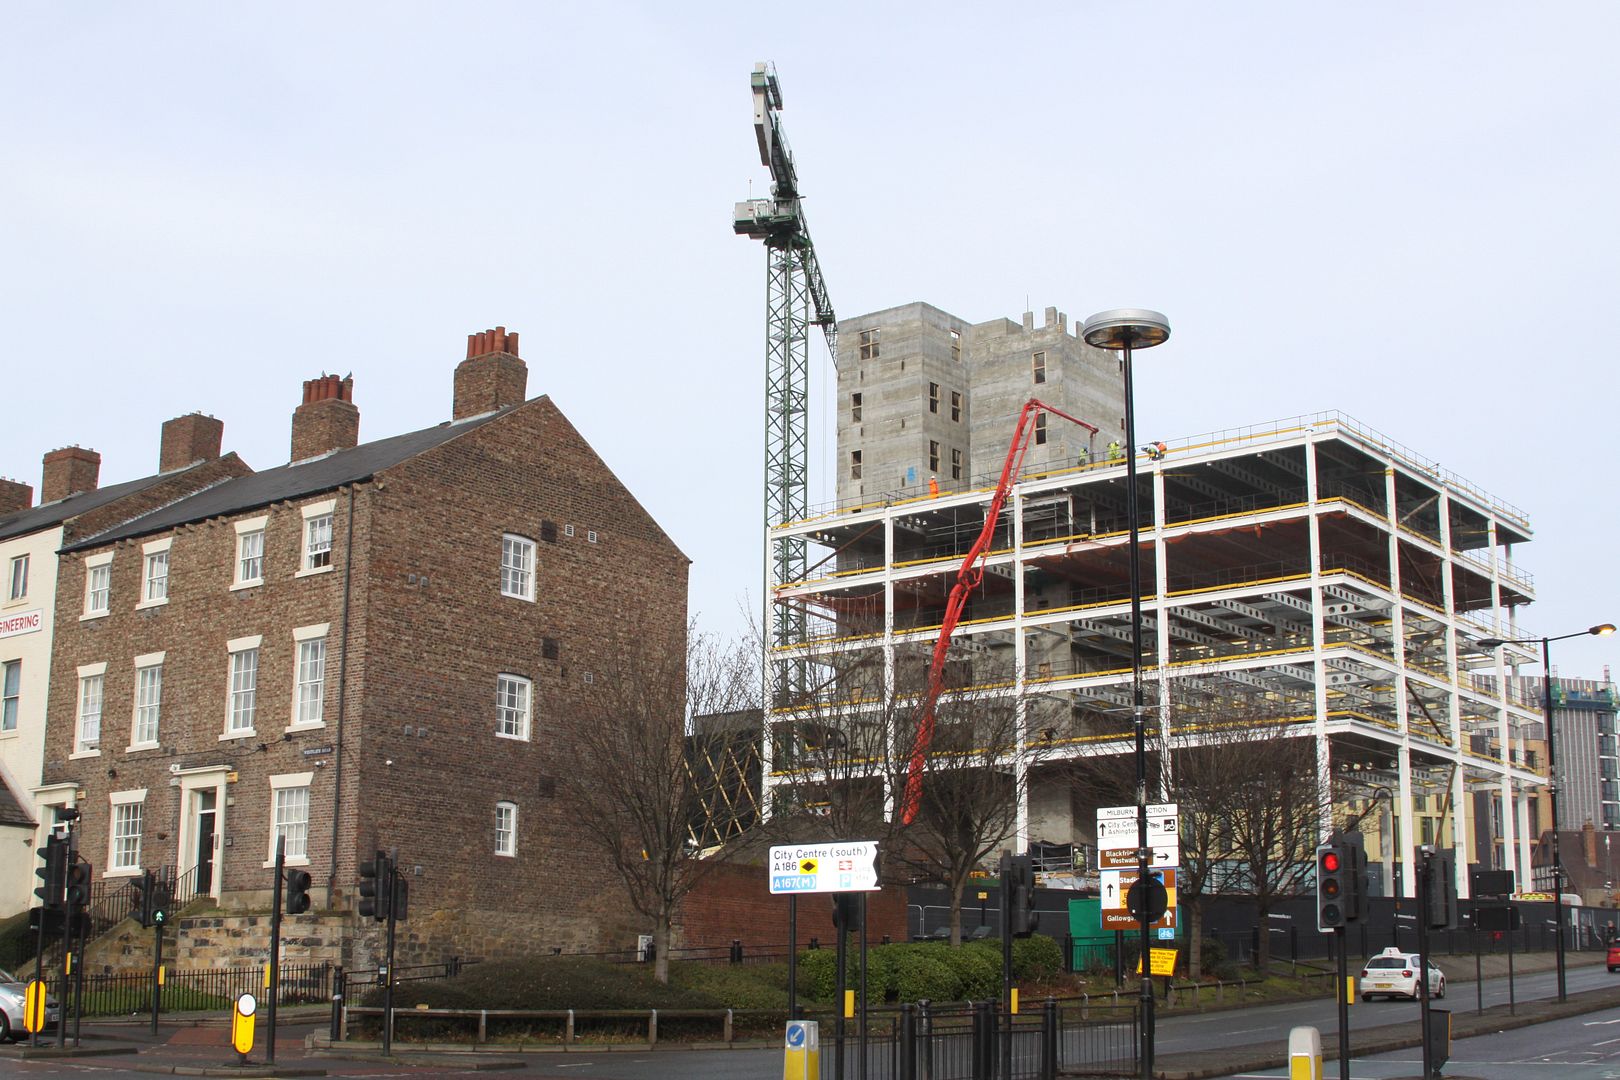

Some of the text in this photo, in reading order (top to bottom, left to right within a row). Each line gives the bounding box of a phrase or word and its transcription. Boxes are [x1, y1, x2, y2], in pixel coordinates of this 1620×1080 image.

[1107, 821, 1120, 829] City
[774, 846, 868, 860] City Centre (south)
[773, 875, 816, 889] A167(M)
